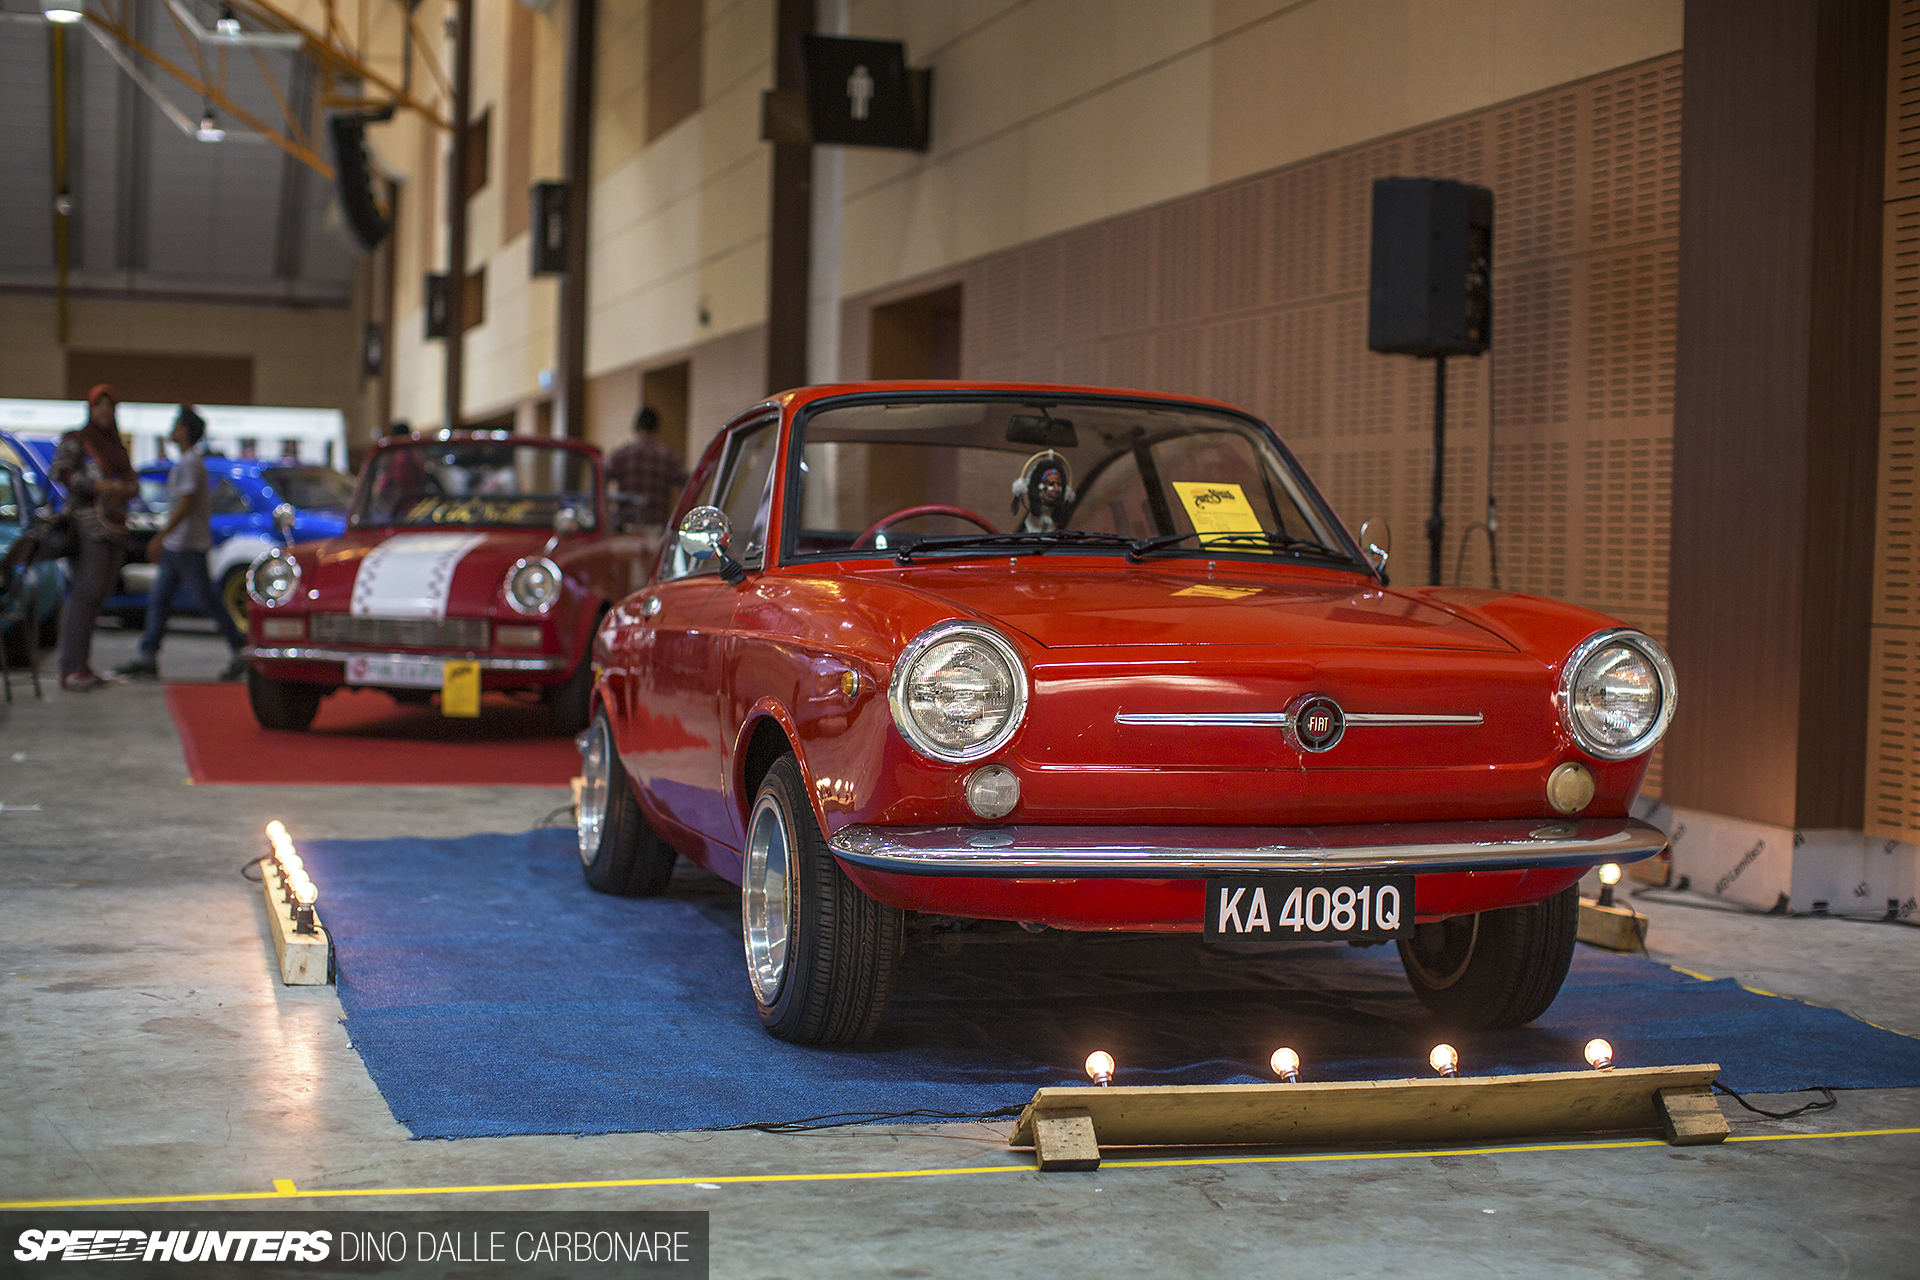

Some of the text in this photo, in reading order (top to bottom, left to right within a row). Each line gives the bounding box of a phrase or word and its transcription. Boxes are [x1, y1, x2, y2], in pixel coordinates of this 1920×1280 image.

[1308, 716, 1330, 732] FIAT
[1218, 885, 1401, 933] KA 4081Q
